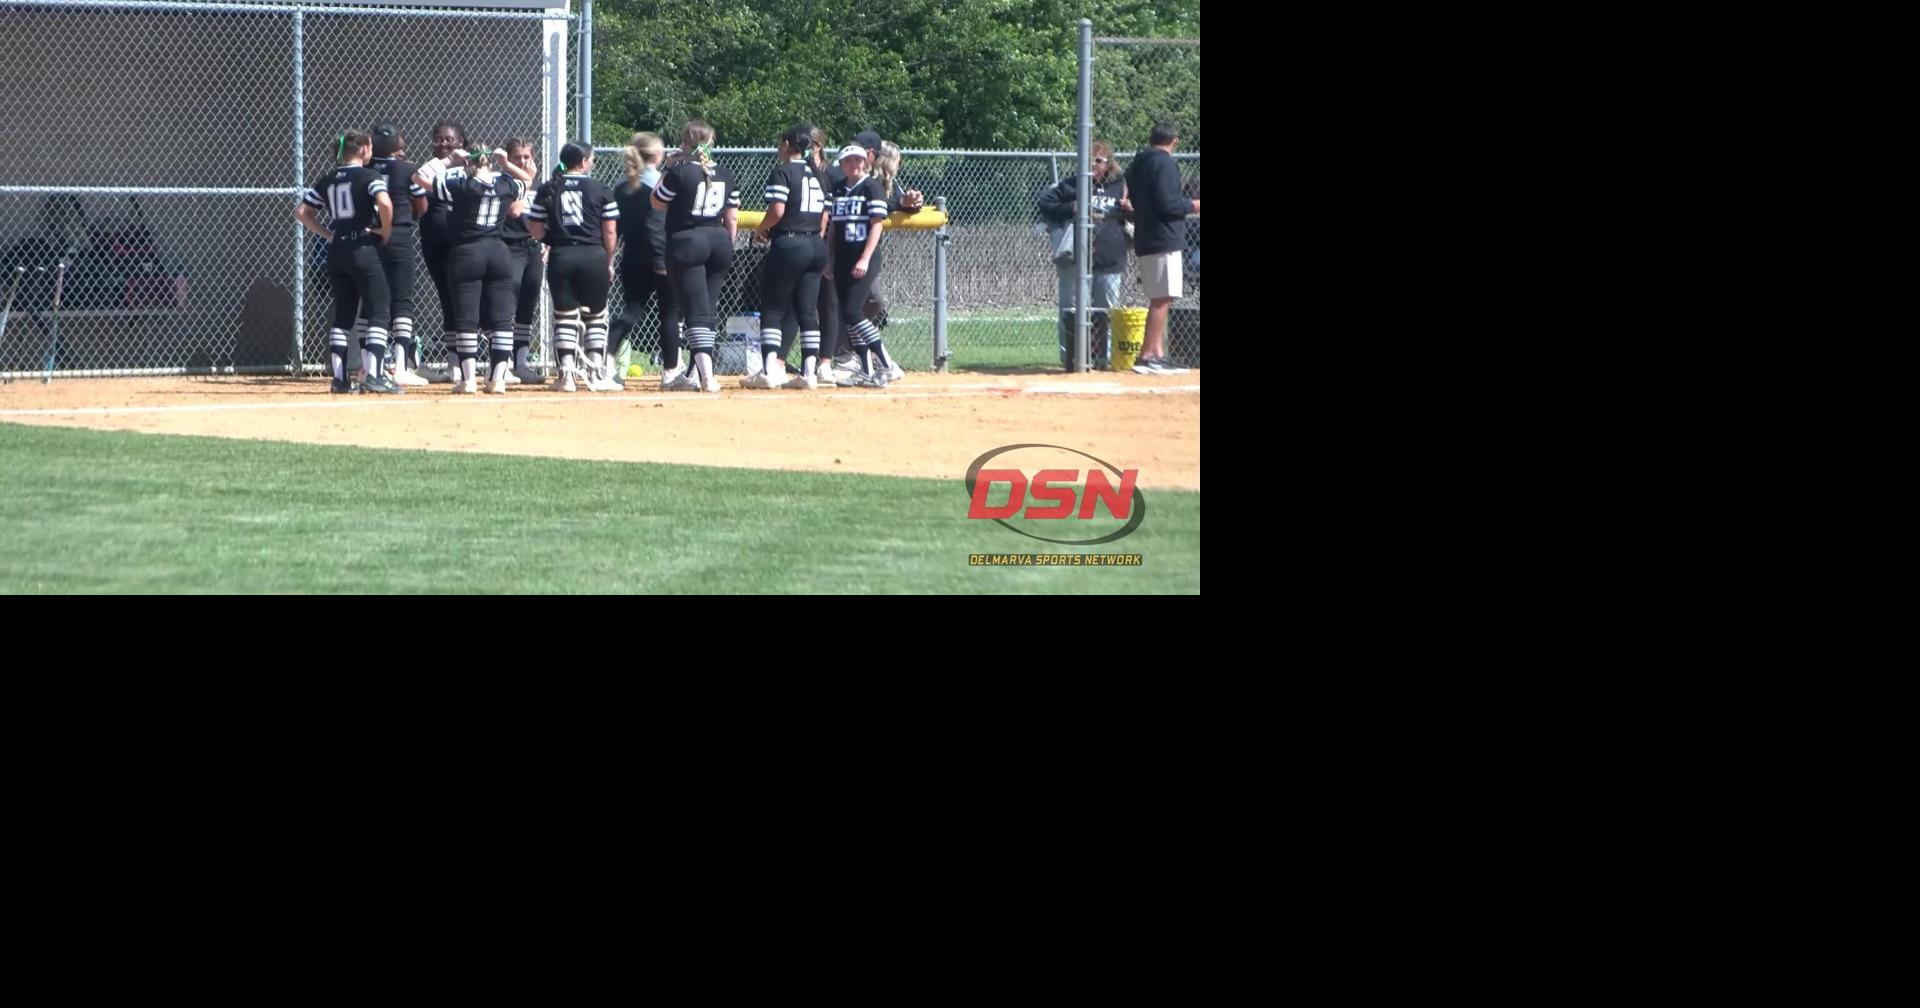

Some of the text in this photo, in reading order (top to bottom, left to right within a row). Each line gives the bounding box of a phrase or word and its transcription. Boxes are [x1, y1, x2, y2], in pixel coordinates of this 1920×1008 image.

[327, 181, 356, 220] 10
[476, 196, 501, 227] 11
[691, 181, 726, 217] 18
[800, 175, 825, 213] 12
[845, 222, 868, 242] 20
